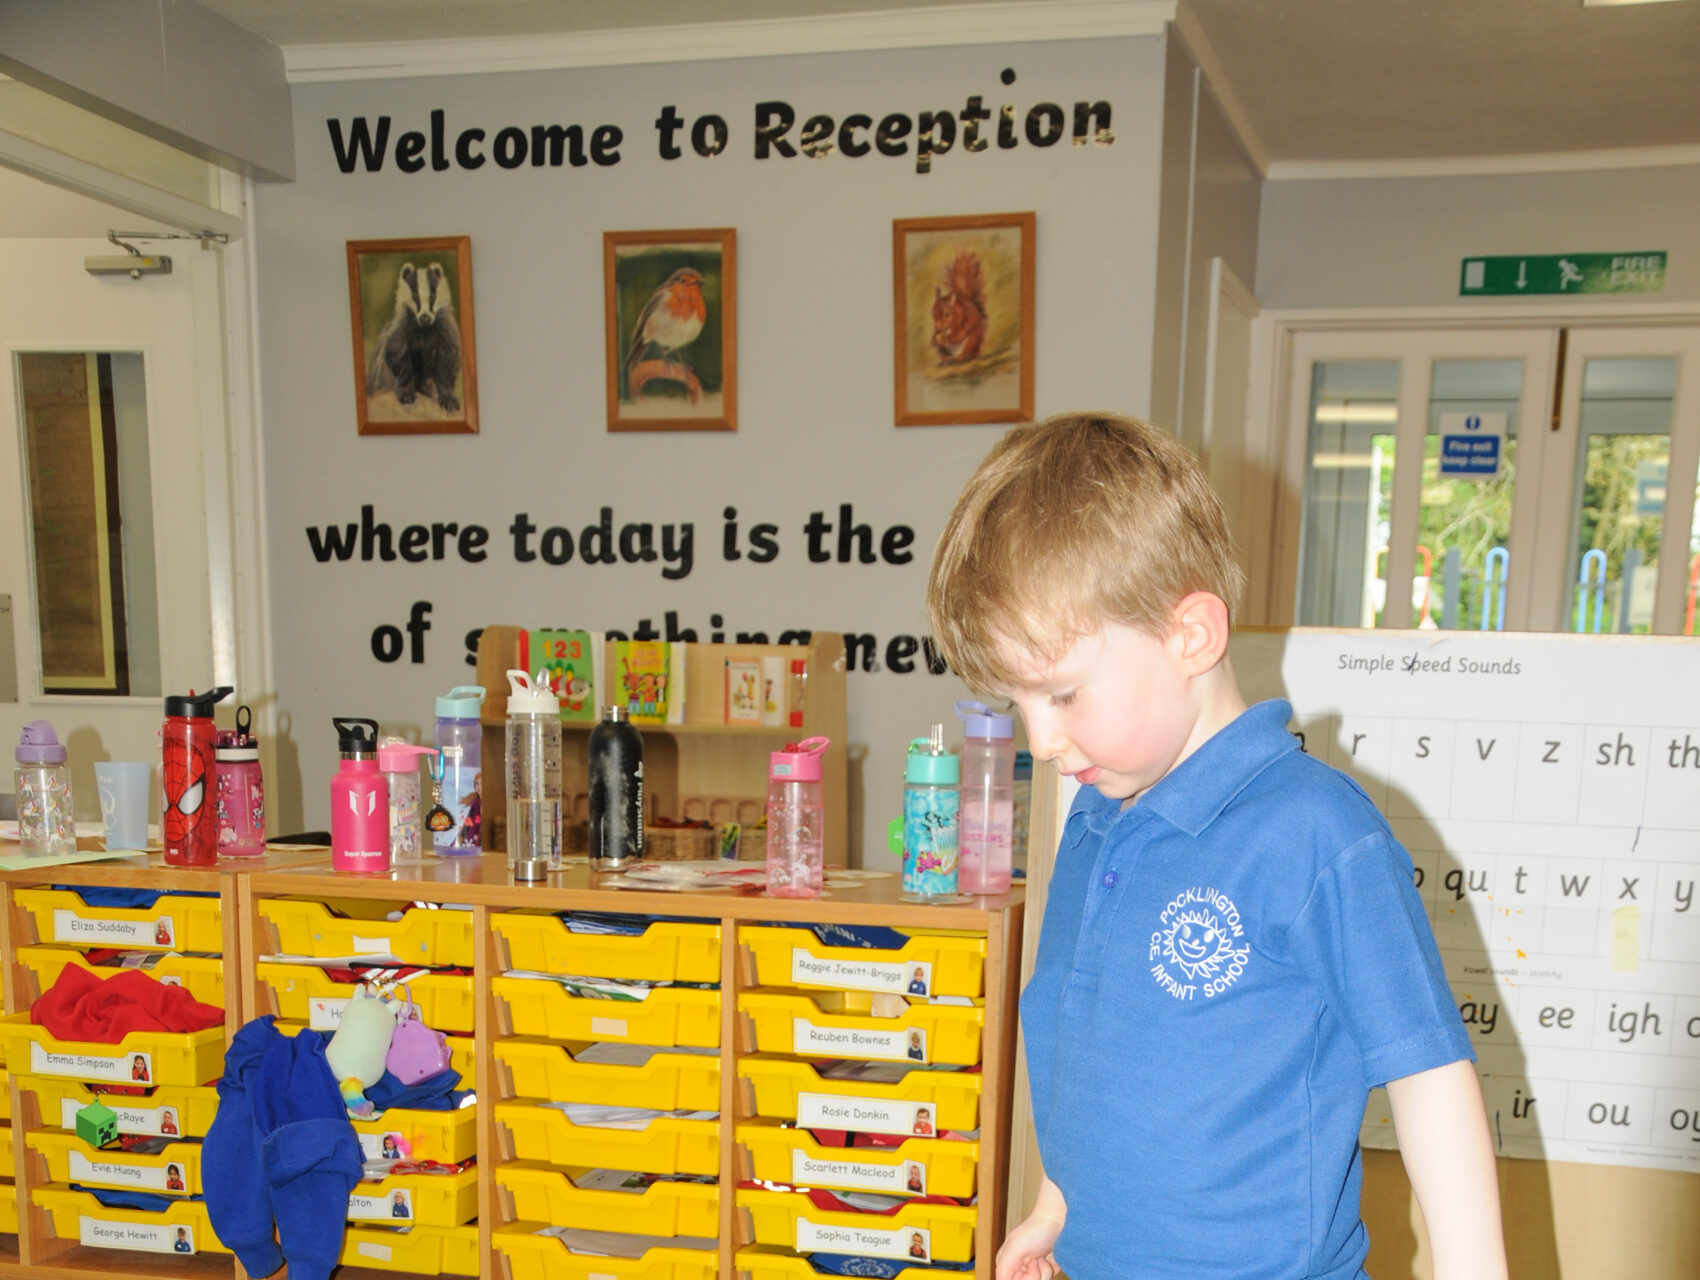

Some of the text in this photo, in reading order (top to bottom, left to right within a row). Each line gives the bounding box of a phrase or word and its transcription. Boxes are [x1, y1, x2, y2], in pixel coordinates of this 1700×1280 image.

[327, 68, 1115, 174] Welcome to Reception
[306, 504, 915, 580] where today is the
[371, 601, 432, 663] of
[1338, 652, 1522, 676] Simple Speed Sounds
[1352, 733, 1367, 755] r
[1415, 735, 1431, 758] s
[1476, 737, 1497, 760] v
[1541, 740, 1561, 763] z
[1595, 732, 1636, 766] sh
[1668, 734, 1700, 769] th
[1444, 869, 1489, 901] qu
[1515, 866, 1528, 894] t
[1560, 874, 1591, 897] w
[1618, 877, 1640, 900] x
[1674, 880, 1695, 912] y
[1160, 887, 1244, 937] POCKLINGTON
[71, 919, 137, 936] Eliza Suddaby
[799, 959, 832, 975] Reggie
[1151, 964, 1197, 1000] INFANT
[1203, 943, 1250, 997] SCHOOL
[1459, 1002, 1499, 1034] ay
[1538, 1006, 1575, 1029] ee
[1607, 1002, 1662, 1043] igh
[810, 1030, 892, 1047] Reuben Bownes
[46, 1052, 116, 1071] Emma Simpson
[822, 1105, 890, 1121] Rosie Donkin
[1512, 1089, 1537, 1119] ir
[1588, 1102, 1631, 1126] ou
[116, 1112, 145, 1124] cRaye
[92, 1161, 142, 1179] Evie Huang
[804, 1159, 896, 1178] Scarlett Macleod
[348, 1198, 372, 1207] alton
[93, 1226, 158, 1242] George Hewitt
[815, 1228, 892, 1248] Sophia Teague
